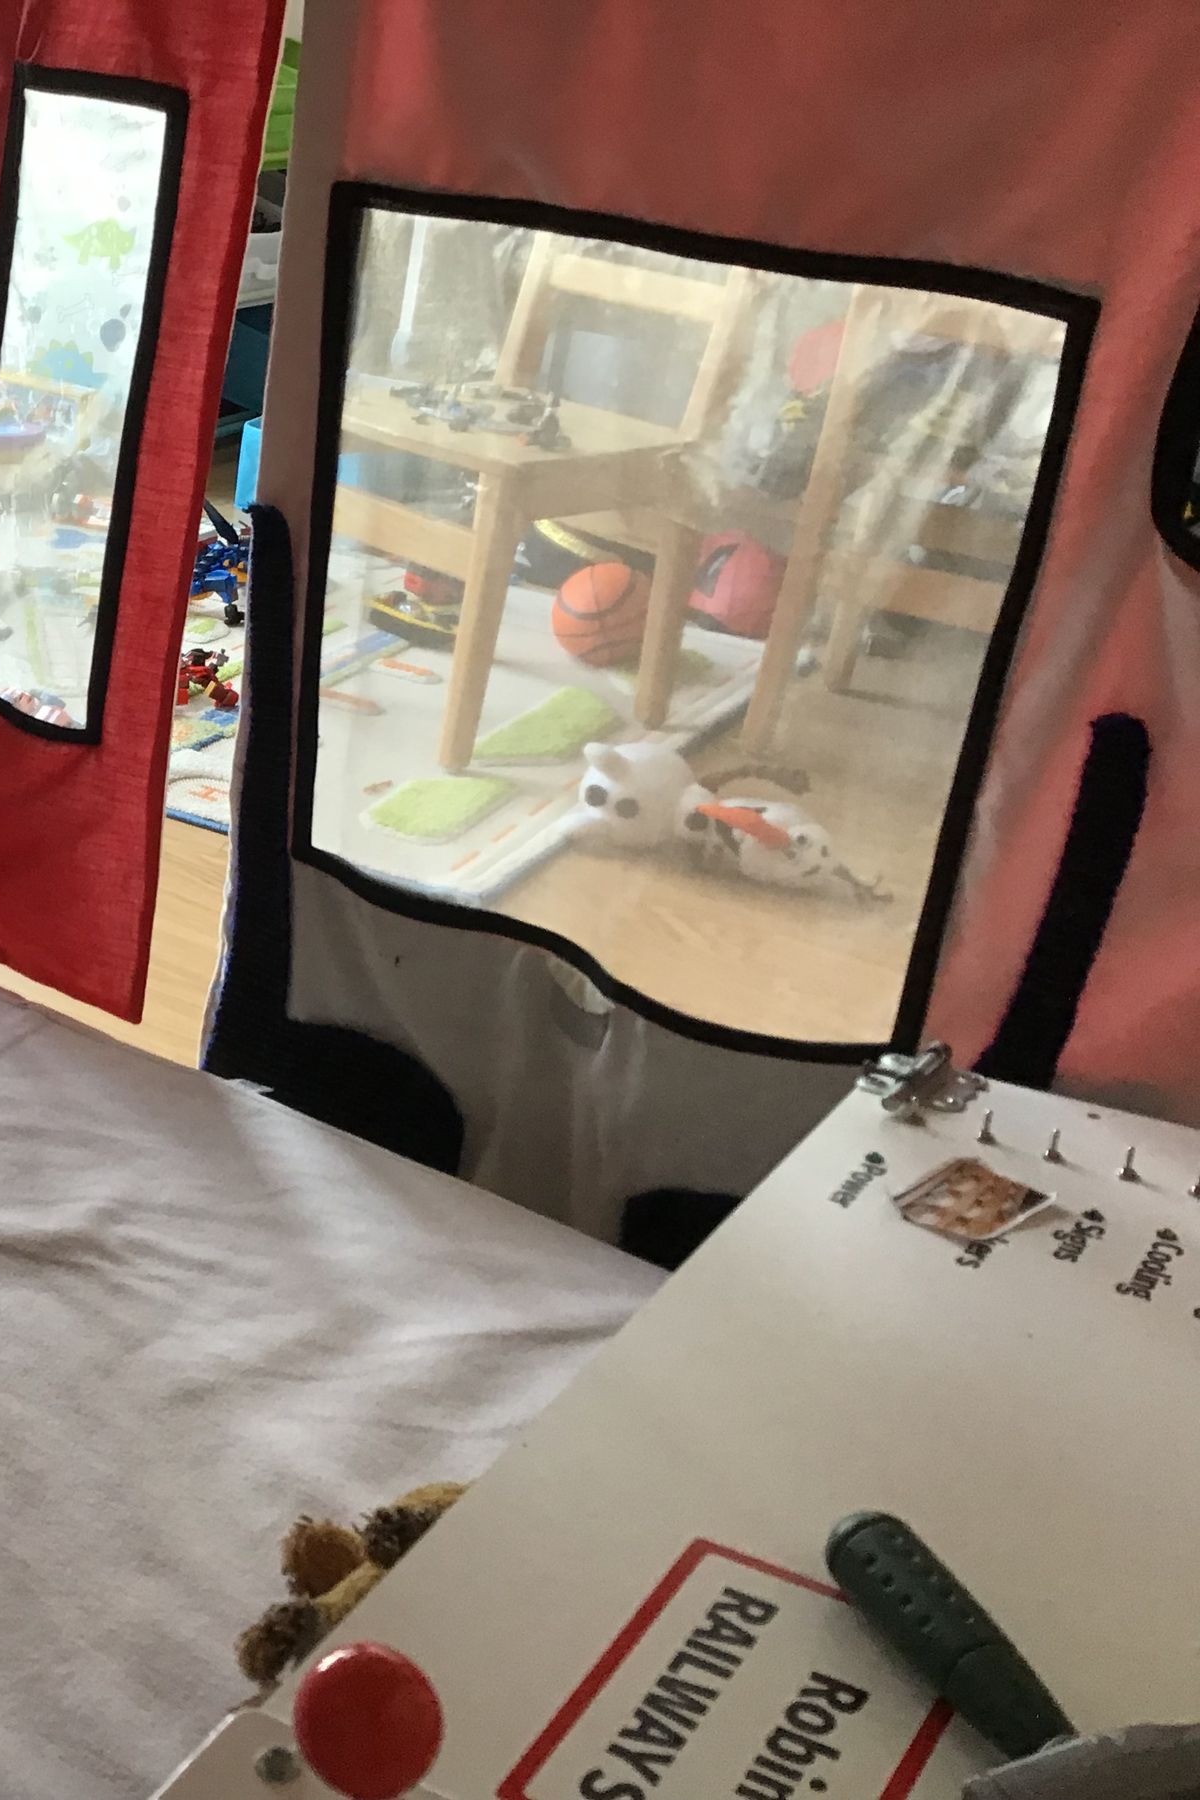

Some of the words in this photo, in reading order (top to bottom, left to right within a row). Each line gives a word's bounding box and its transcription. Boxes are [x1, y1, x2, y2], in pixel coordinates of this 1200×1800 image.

[1053, 1220, 1105, 1263] Signs
[1115, 1241, 1184, 1302] Cooling
[578, 1586, 780, 1800] RAILWAYS
